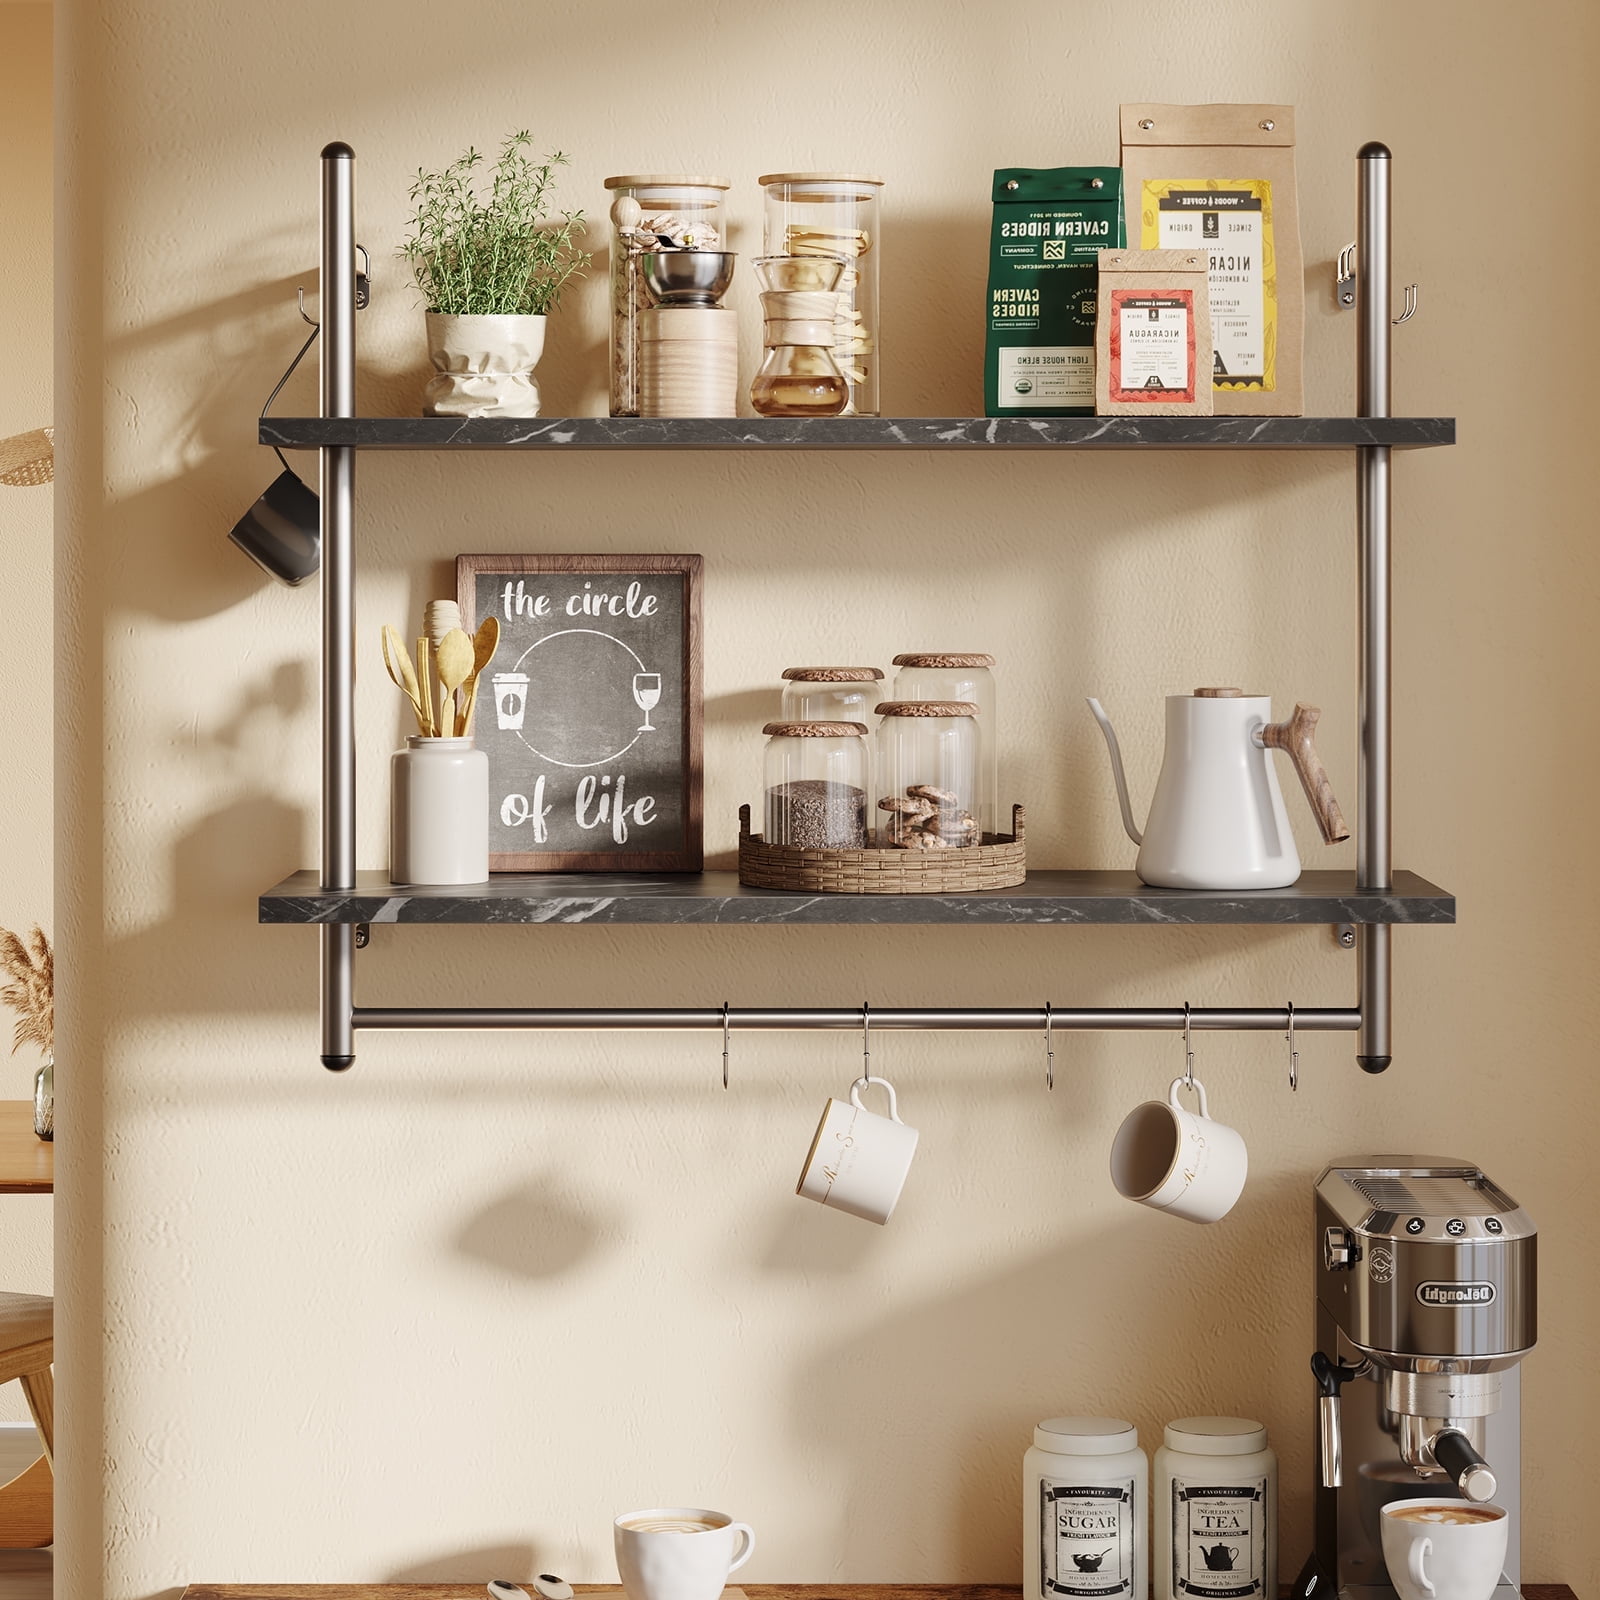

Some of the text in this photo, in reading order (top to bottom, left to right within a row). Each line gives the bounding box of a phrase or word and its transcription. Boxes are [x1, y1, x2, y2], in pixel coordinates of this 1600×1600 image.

[500, 580, 659, 622] the circle
[500, 774, 658, 845] of life
[1059, 1515, 1117, 1529] SUGAR
[1200, 1515, 1241, 1529] TEA
